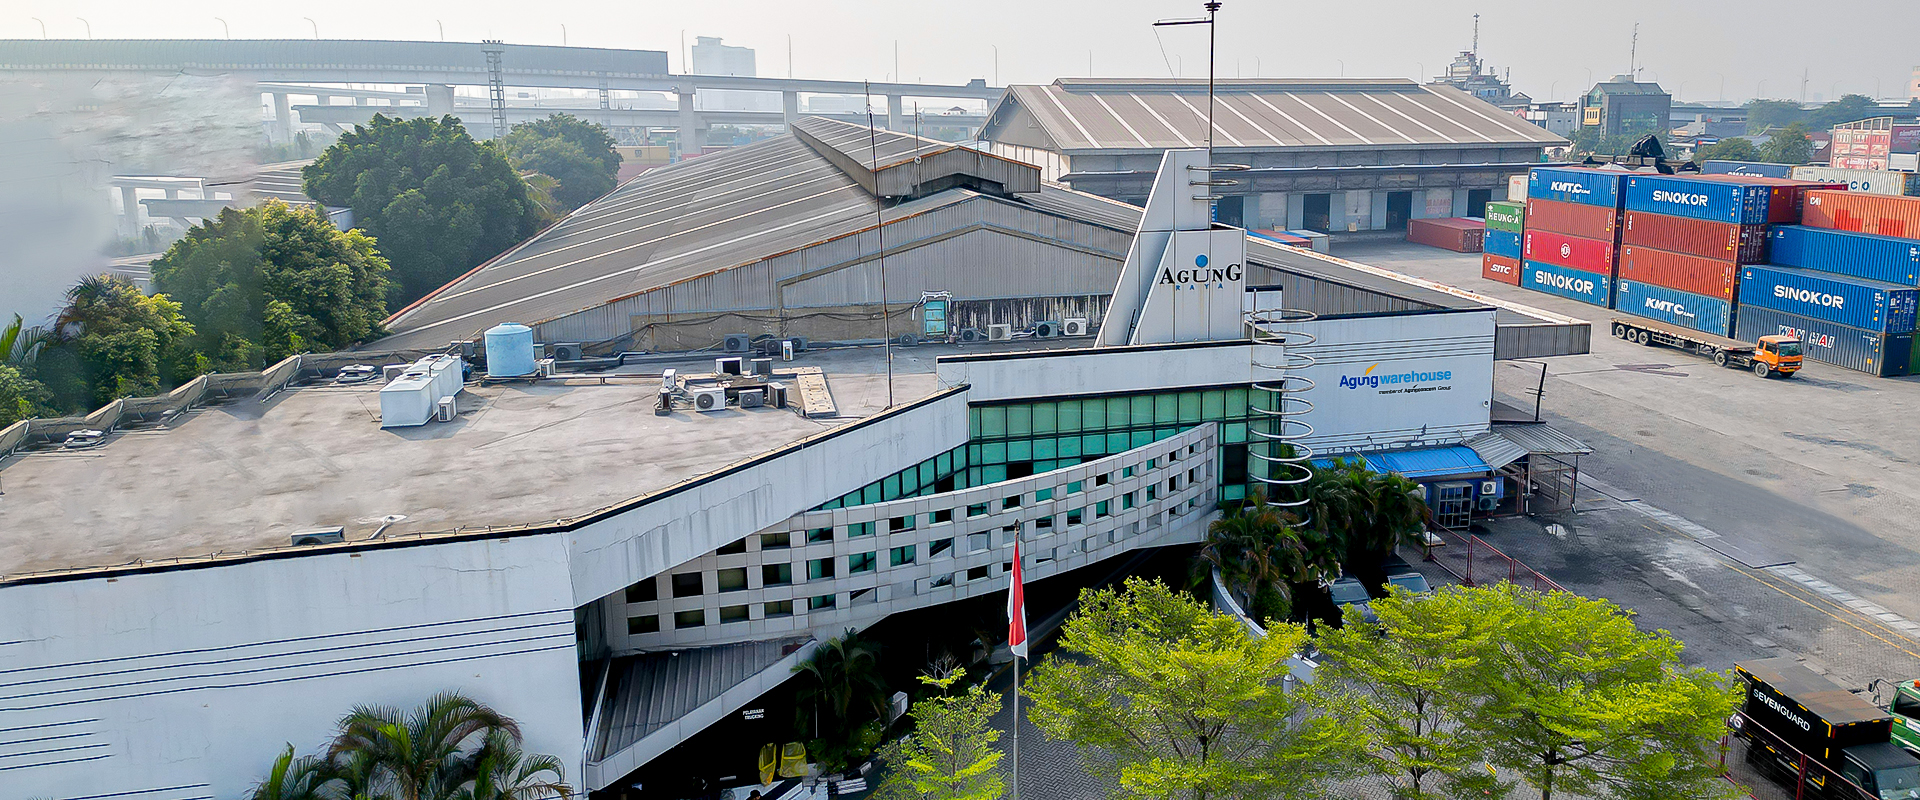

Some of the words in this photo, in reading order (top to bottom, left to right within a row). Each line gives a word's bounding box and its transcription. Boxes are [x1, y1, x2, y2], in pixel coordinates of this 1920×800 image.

[1550, 181, 1583, 194] KMTC
[1652, 190, 1709, 207] SINOKOR
[1488, 211, 1520, 225] HEUNG-A
[1159, 263, 1242, 285] AGUNG
[1490, 263, 1512, 275] SITC
[1175, 282, 1223, 291] RAYA
[1535, 270, 1594, 296] SINOKOR
[1773, 284, 1844, 310] SINOKOR
[1644, 297, 1685, 315] KMTC
[1778, 324, 1806, 342] WAN
[1808, 332, 1836, 349] HAI
[1379, 370, 1452, 385] warehouse
[1753, 688, 1811, 732] SEVENGUARD
